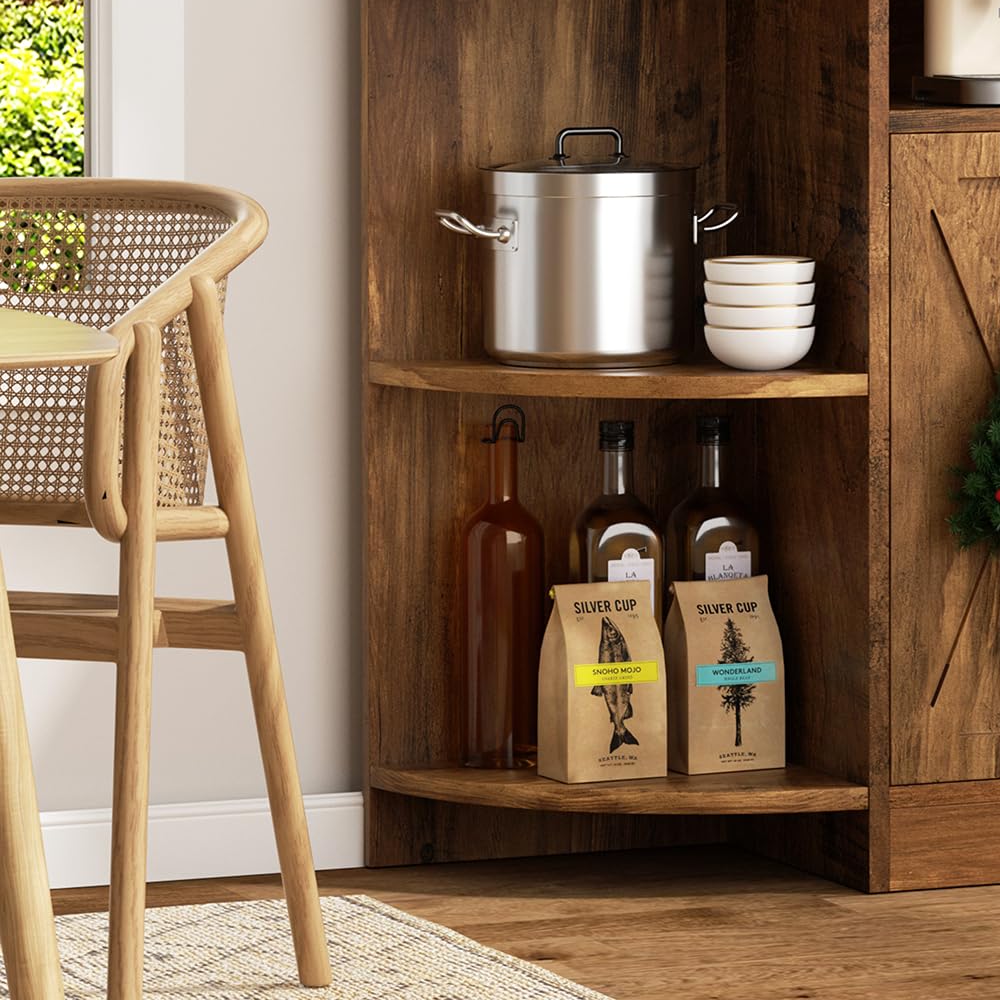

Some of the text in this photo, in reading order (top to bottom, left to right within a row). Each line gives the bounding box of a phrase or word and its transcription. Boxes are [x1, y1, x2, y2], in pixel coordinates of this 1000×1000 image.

[574, 599, 637, 614] SILVER CUP
[696, 601, 758, 615] SILVER CUP
[592, 666, 642, 676] SNOHO MOJO
[712, 666, 762, 676] WONDERLAND
